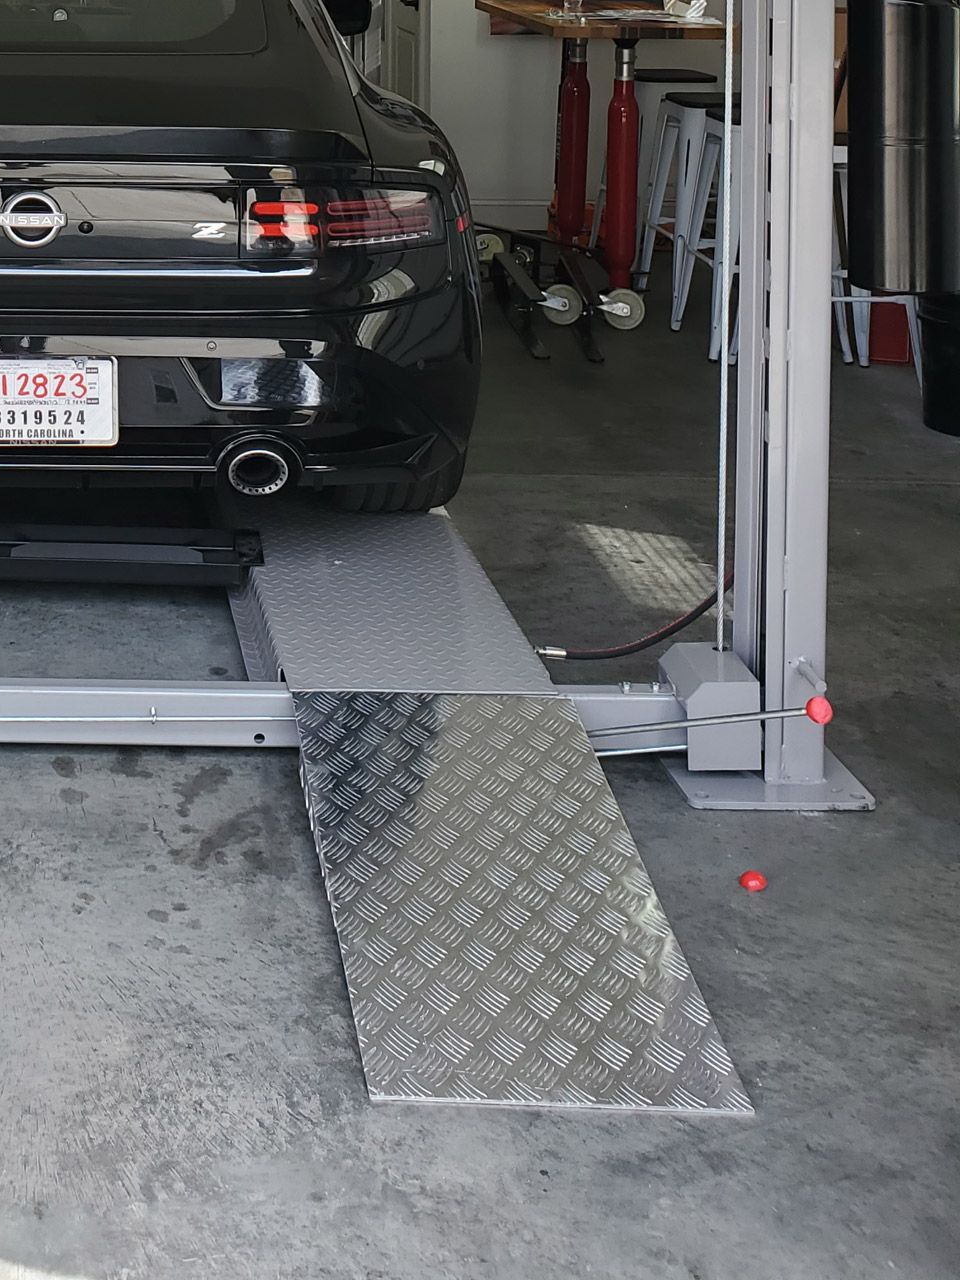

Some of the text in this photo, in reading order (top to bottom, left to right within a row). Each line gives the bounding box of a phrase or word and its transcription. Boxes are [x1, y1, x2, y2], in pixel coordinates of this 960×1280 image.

[0, 215, 65, 225] NISSAN
[191, 222, 228, 239] Z
[26, 429, 74, 439] CAROLINA
